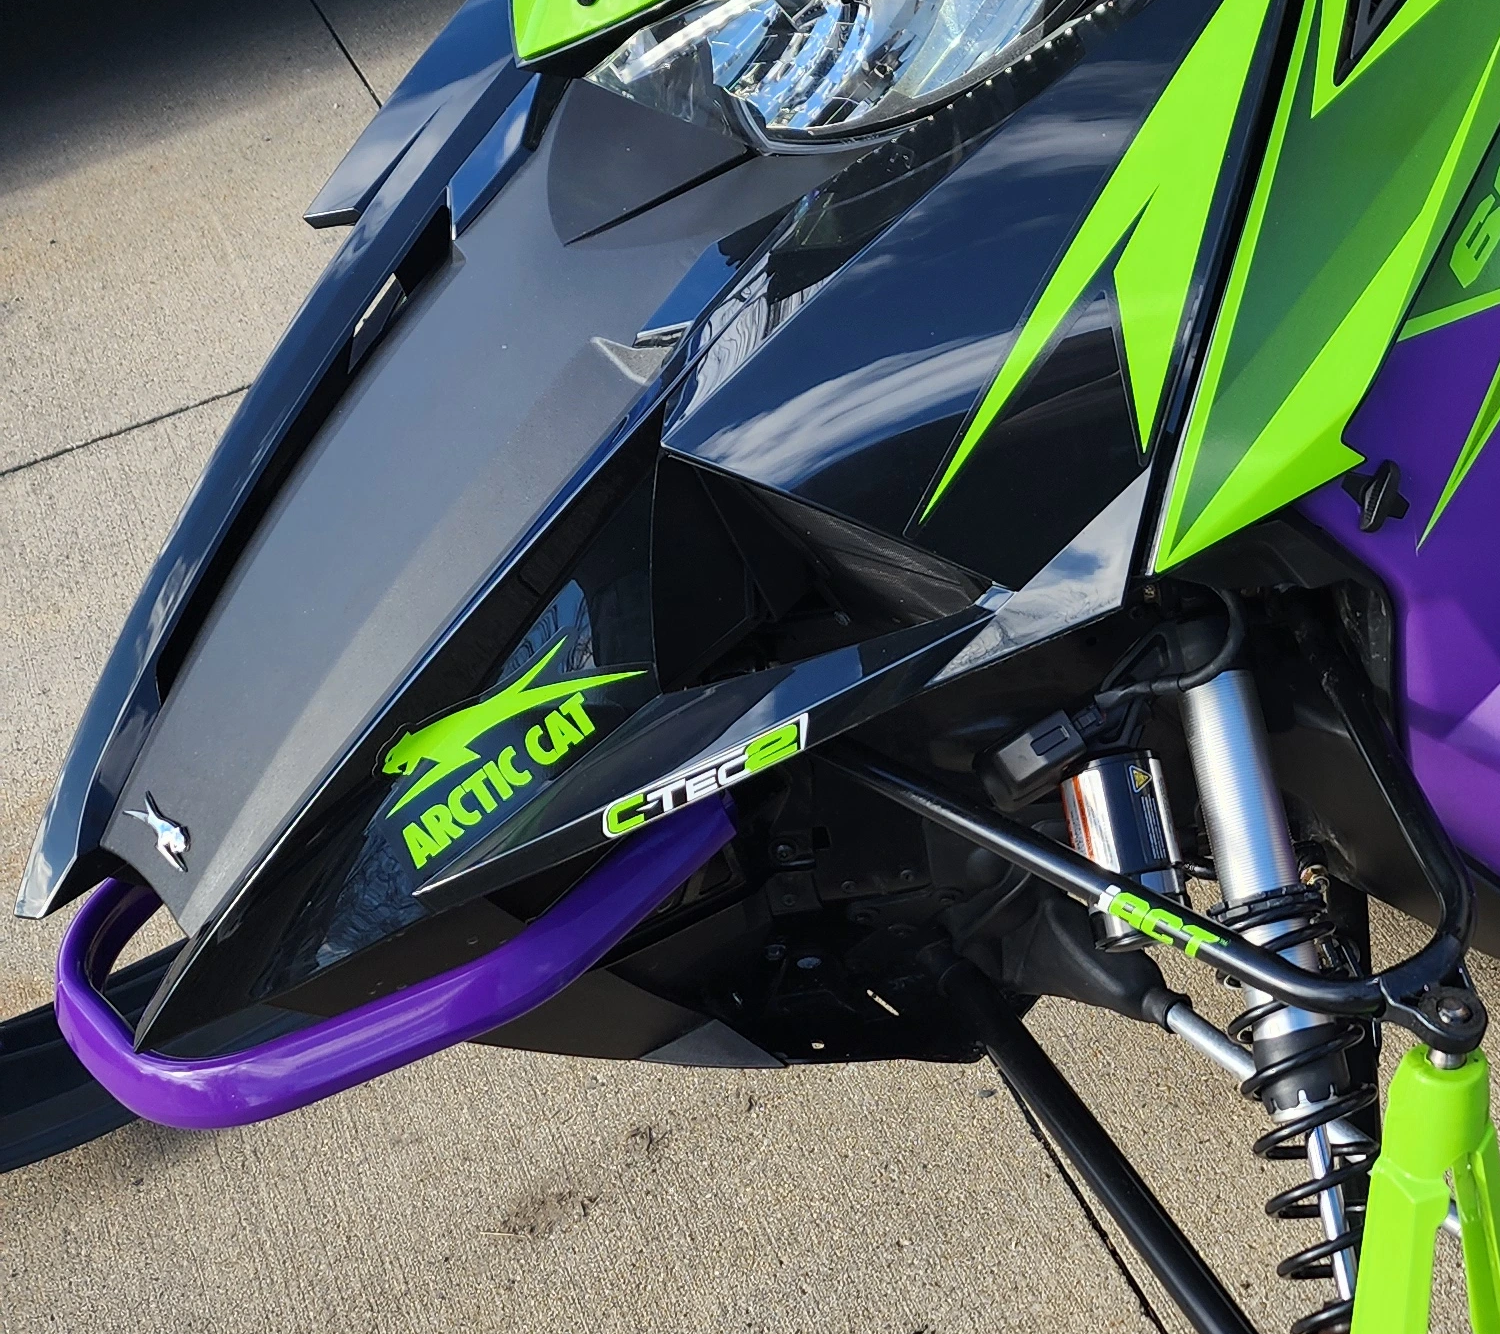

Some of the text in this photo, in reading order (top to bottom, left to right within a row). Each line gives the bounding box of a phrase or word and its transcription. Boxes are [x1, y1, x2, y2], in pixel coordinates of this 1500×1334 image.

[402, 692, 596, 869] ARCTIC CAT
[606, 723, 799, 836] C-TEC2
